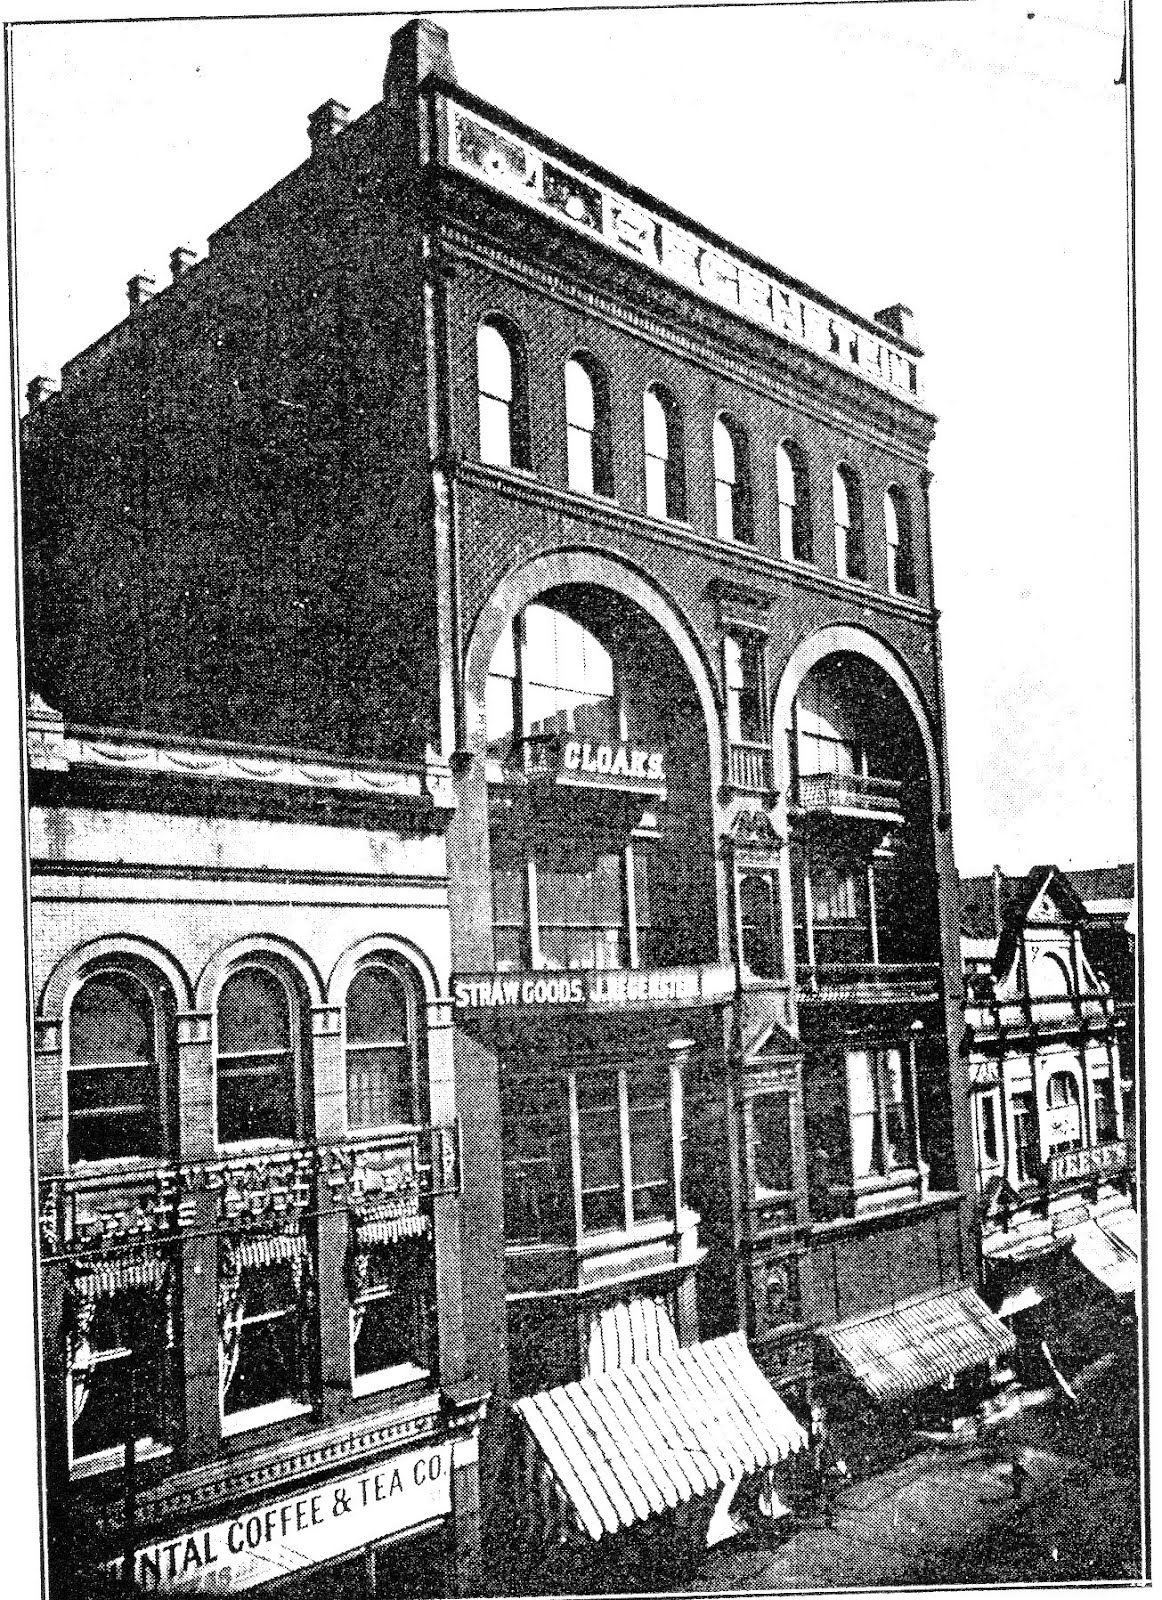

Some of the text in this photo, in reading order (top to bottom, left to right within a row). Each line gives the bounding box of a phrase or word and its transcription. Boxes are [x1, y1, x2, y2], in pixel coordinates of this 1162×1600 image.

[454, 982, 520, 1007] STRAW
[137, 1532, 218, 1587] NTAL
[227, 1495, 324, 1554] COFFEE
[332, 1488, 351, 1517] &
[358, 1468, 403, 1509] TEA
